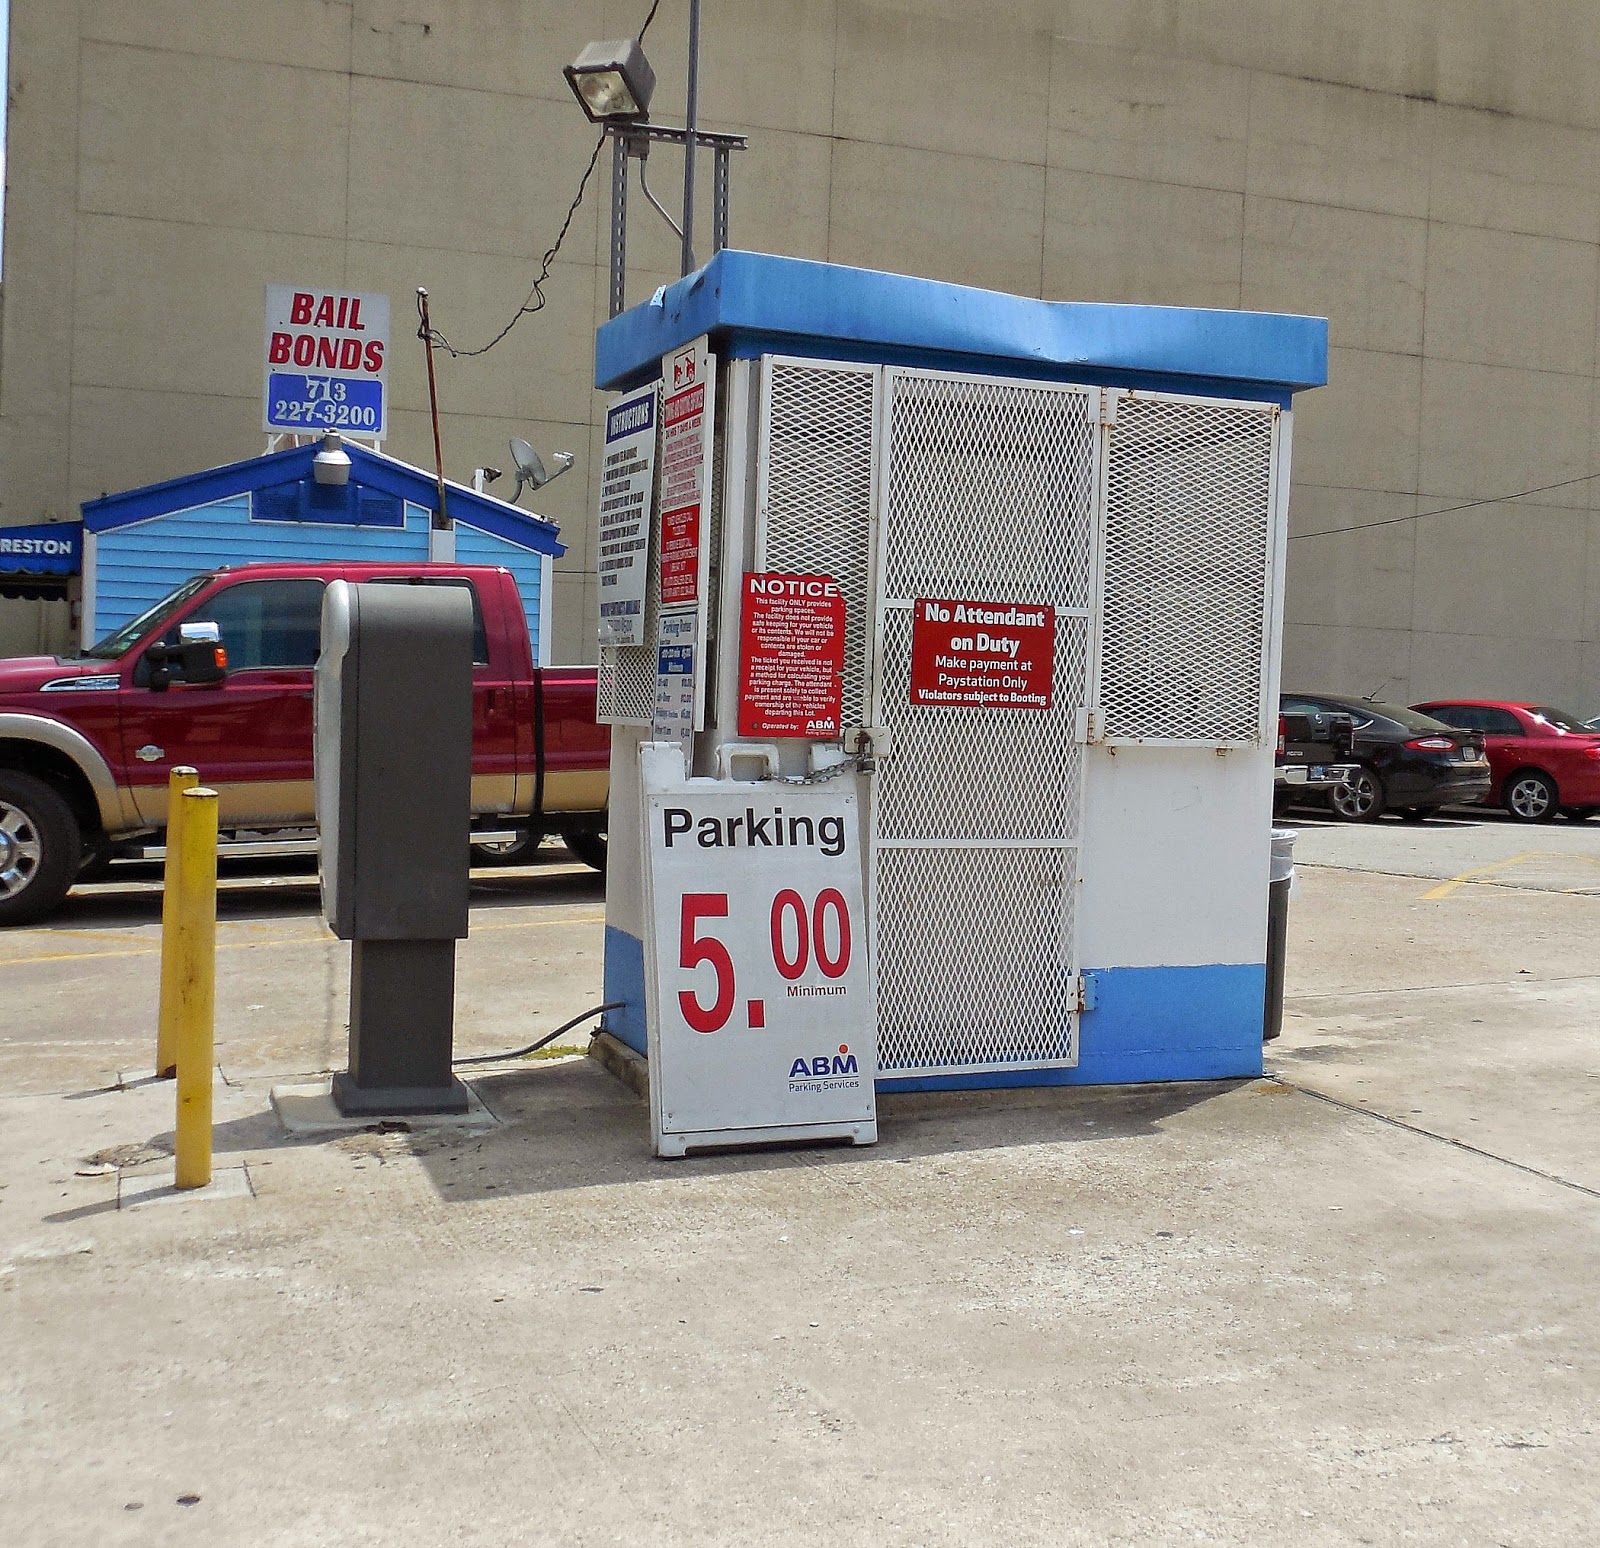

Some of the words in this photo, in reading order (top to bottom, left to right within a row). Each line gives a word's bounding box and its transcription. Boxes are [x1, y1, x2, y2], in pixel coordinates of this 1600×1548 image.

[290, 293, 365, 330] BAIL
[269, 332, 384, 372] BONDS
[307, 380, 346, 401] 713
[275, 400, 375, 425] 227-3200
[0, 539, 72, 554] RESTON
[751, 579, 838, 597] NOTICE
[769, 598, 788, 606] facility
[771, 606, 793, 614] parking
[766, 613, 784, 621] facility
[925, 603, 949, 621] No
[954, 605, 1045, 626] Attendant
[951, 637, 973, 650] on
[977, 633, 1020, 658] Duty
[935, 655, 966, 668] Make
[969, 659, 1018, 672] payment
[1020, 660, 1032, 671] at
[938, 673, 999, 689] Paystation
[1003, 676, 1027, 691] Only
[820, 695, 835, 703] verify
[918, 689, 962, 700] Violators
[963, 691, 998, 703] subject
[999, 694, 1009, 702] to
[1011, 693, 1046, 706] Booting
[765, 709, 792, 717] departing
[806, 720, 834, 728] ABM
[663, 806, 846, 857] Parking
[787, 984, 847, 998] Minimum
[789, 1055, 858, 1077] ABM
[789, 1083, 821, 1093] Parking
[823, 1080, 859, 1089] Services
